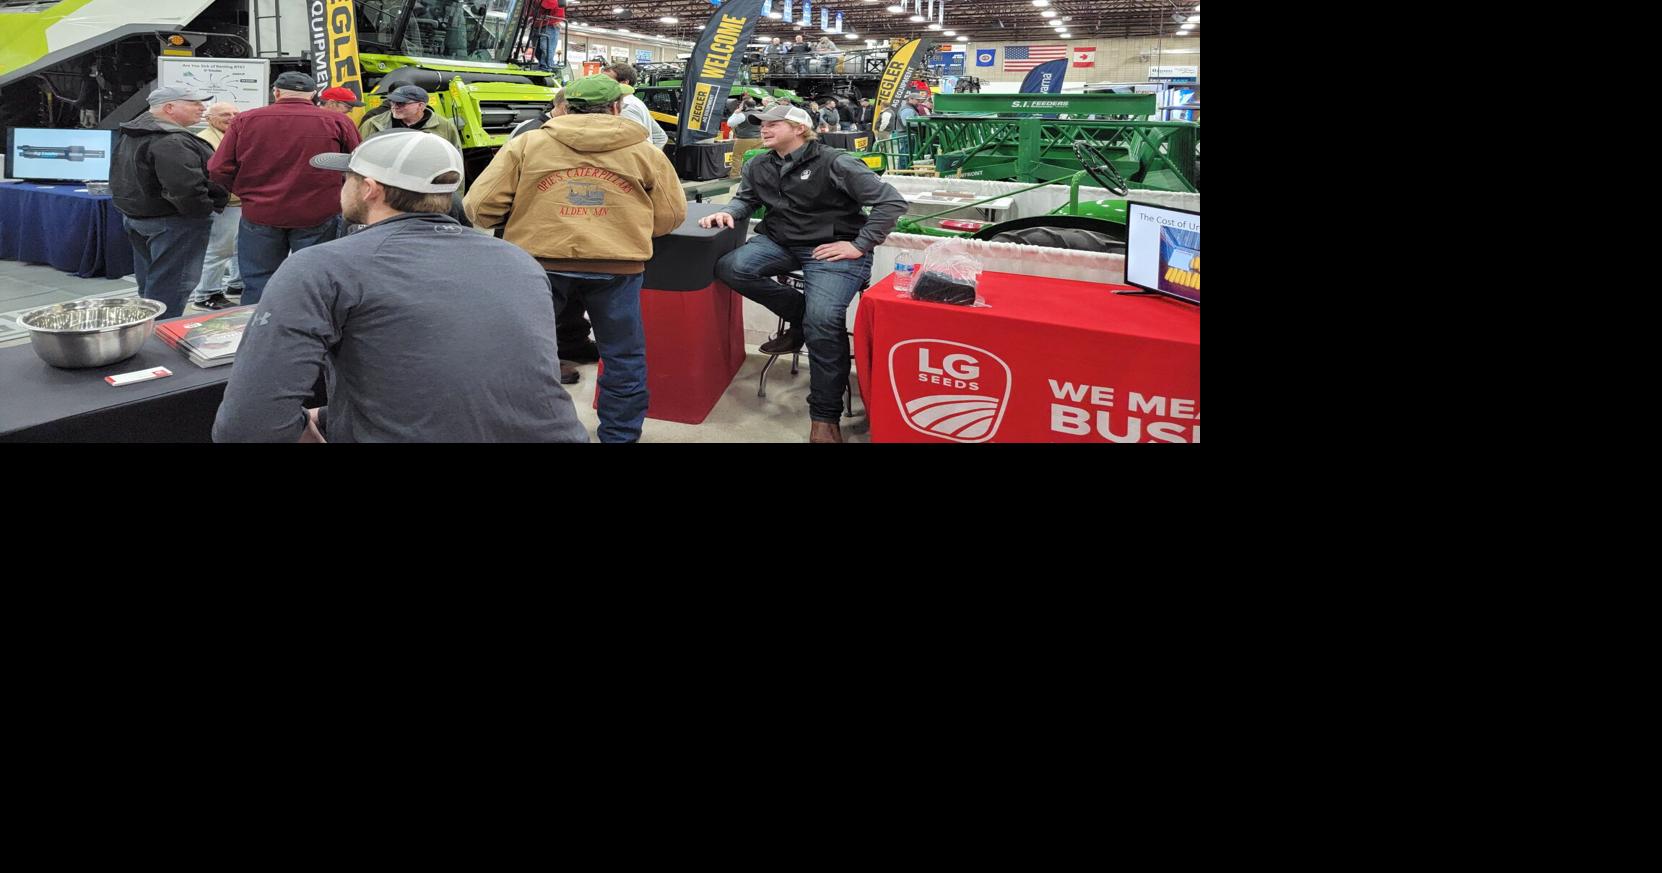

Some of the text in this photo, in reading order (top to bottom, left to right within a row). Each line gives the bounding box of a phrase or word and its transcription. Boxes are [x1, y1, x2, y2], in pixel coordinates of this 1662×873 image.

[331, 0, 362, 100] GLE
[700, 14, 747, 78] WELCOME
[895, 67, 914, 98] EQUIPMENT
[692, 91, 707, 122] ZIEGLER
[537, 172, 563, 192] OPIE'S
[1138, 213, 1154, 222] The
[1157, 216, 1176, 226] Cost
[1177, 220, 1187, 228] of
[919, 348, 980, 380] LG
[918, 373, 980, 391] SEEDS
[1048, 379, 1200, 420] WE ME
